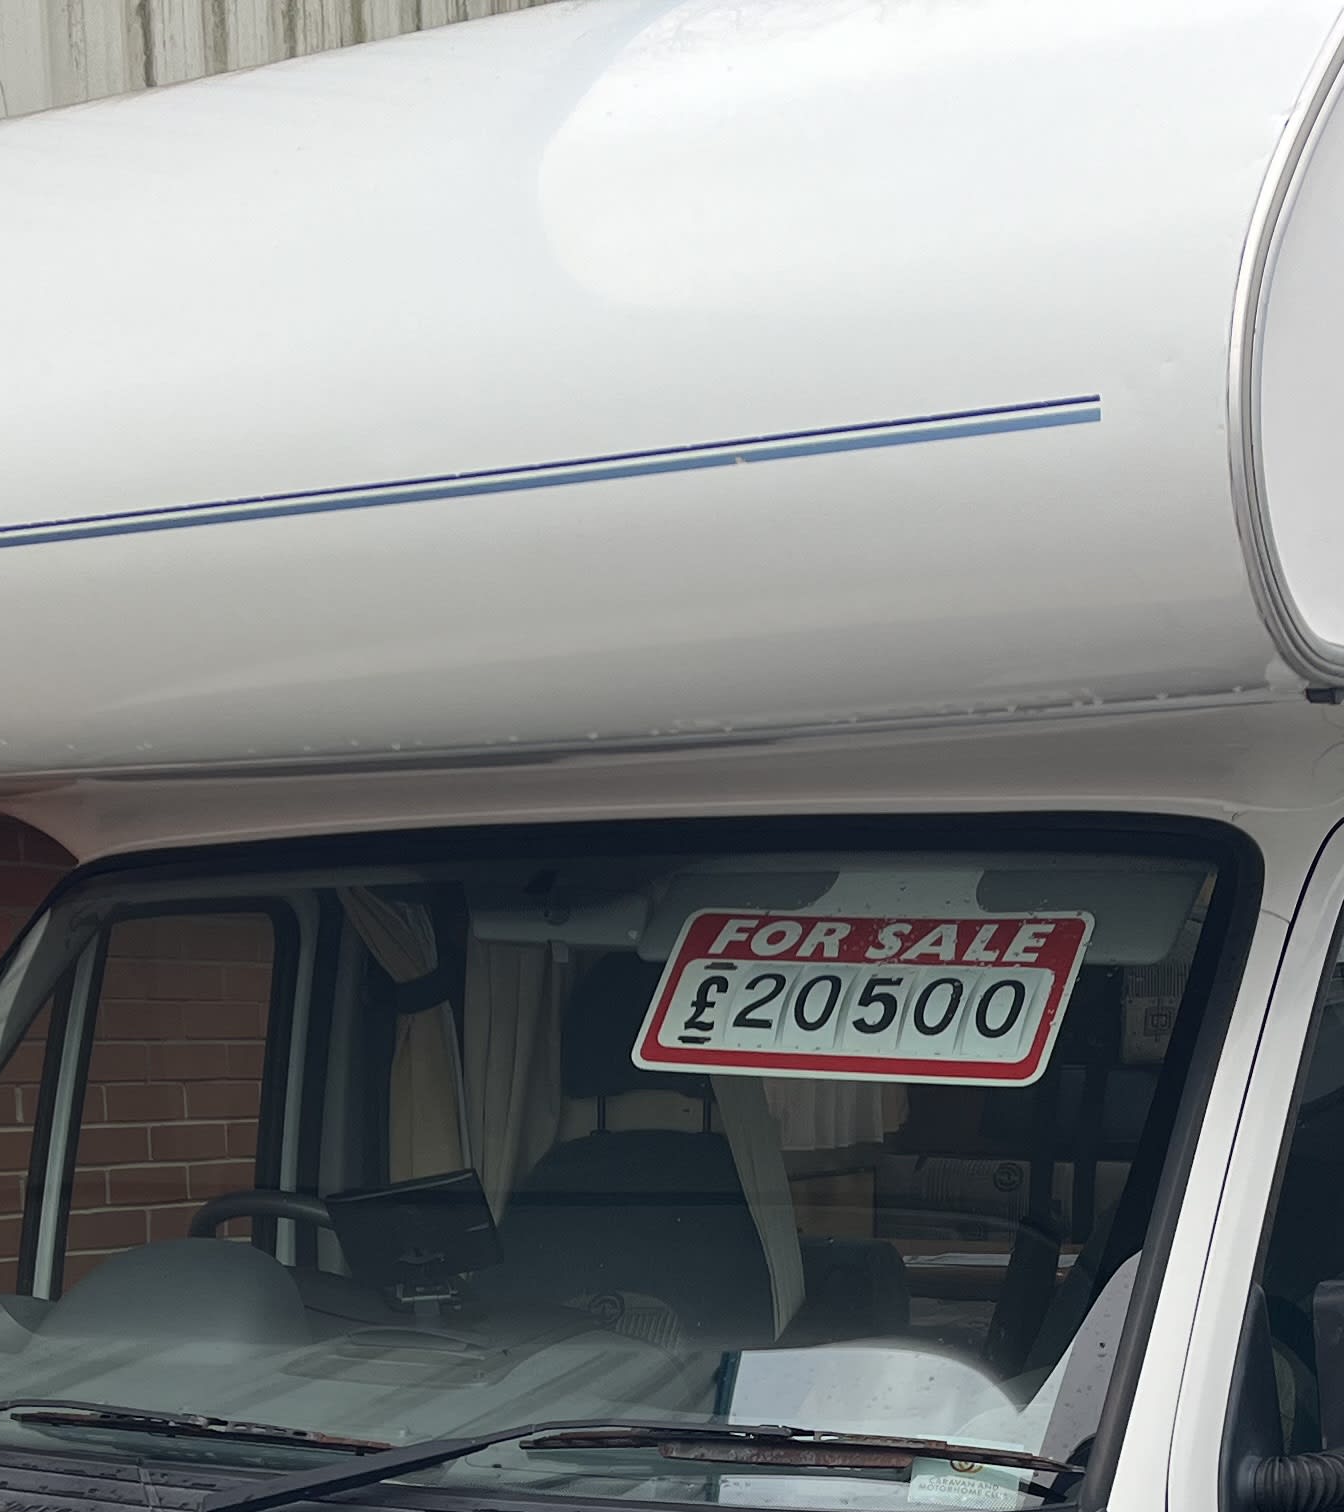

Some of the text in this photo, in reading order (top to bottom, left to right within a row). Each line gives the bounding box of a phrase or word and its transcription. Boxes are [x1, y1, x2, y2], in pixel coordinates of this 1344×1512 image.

[708, 918, 1056, 964] FOR SALE
[682, 972, 1027, 1039] £20500
[979, 1483, 1000, 1491] AND
